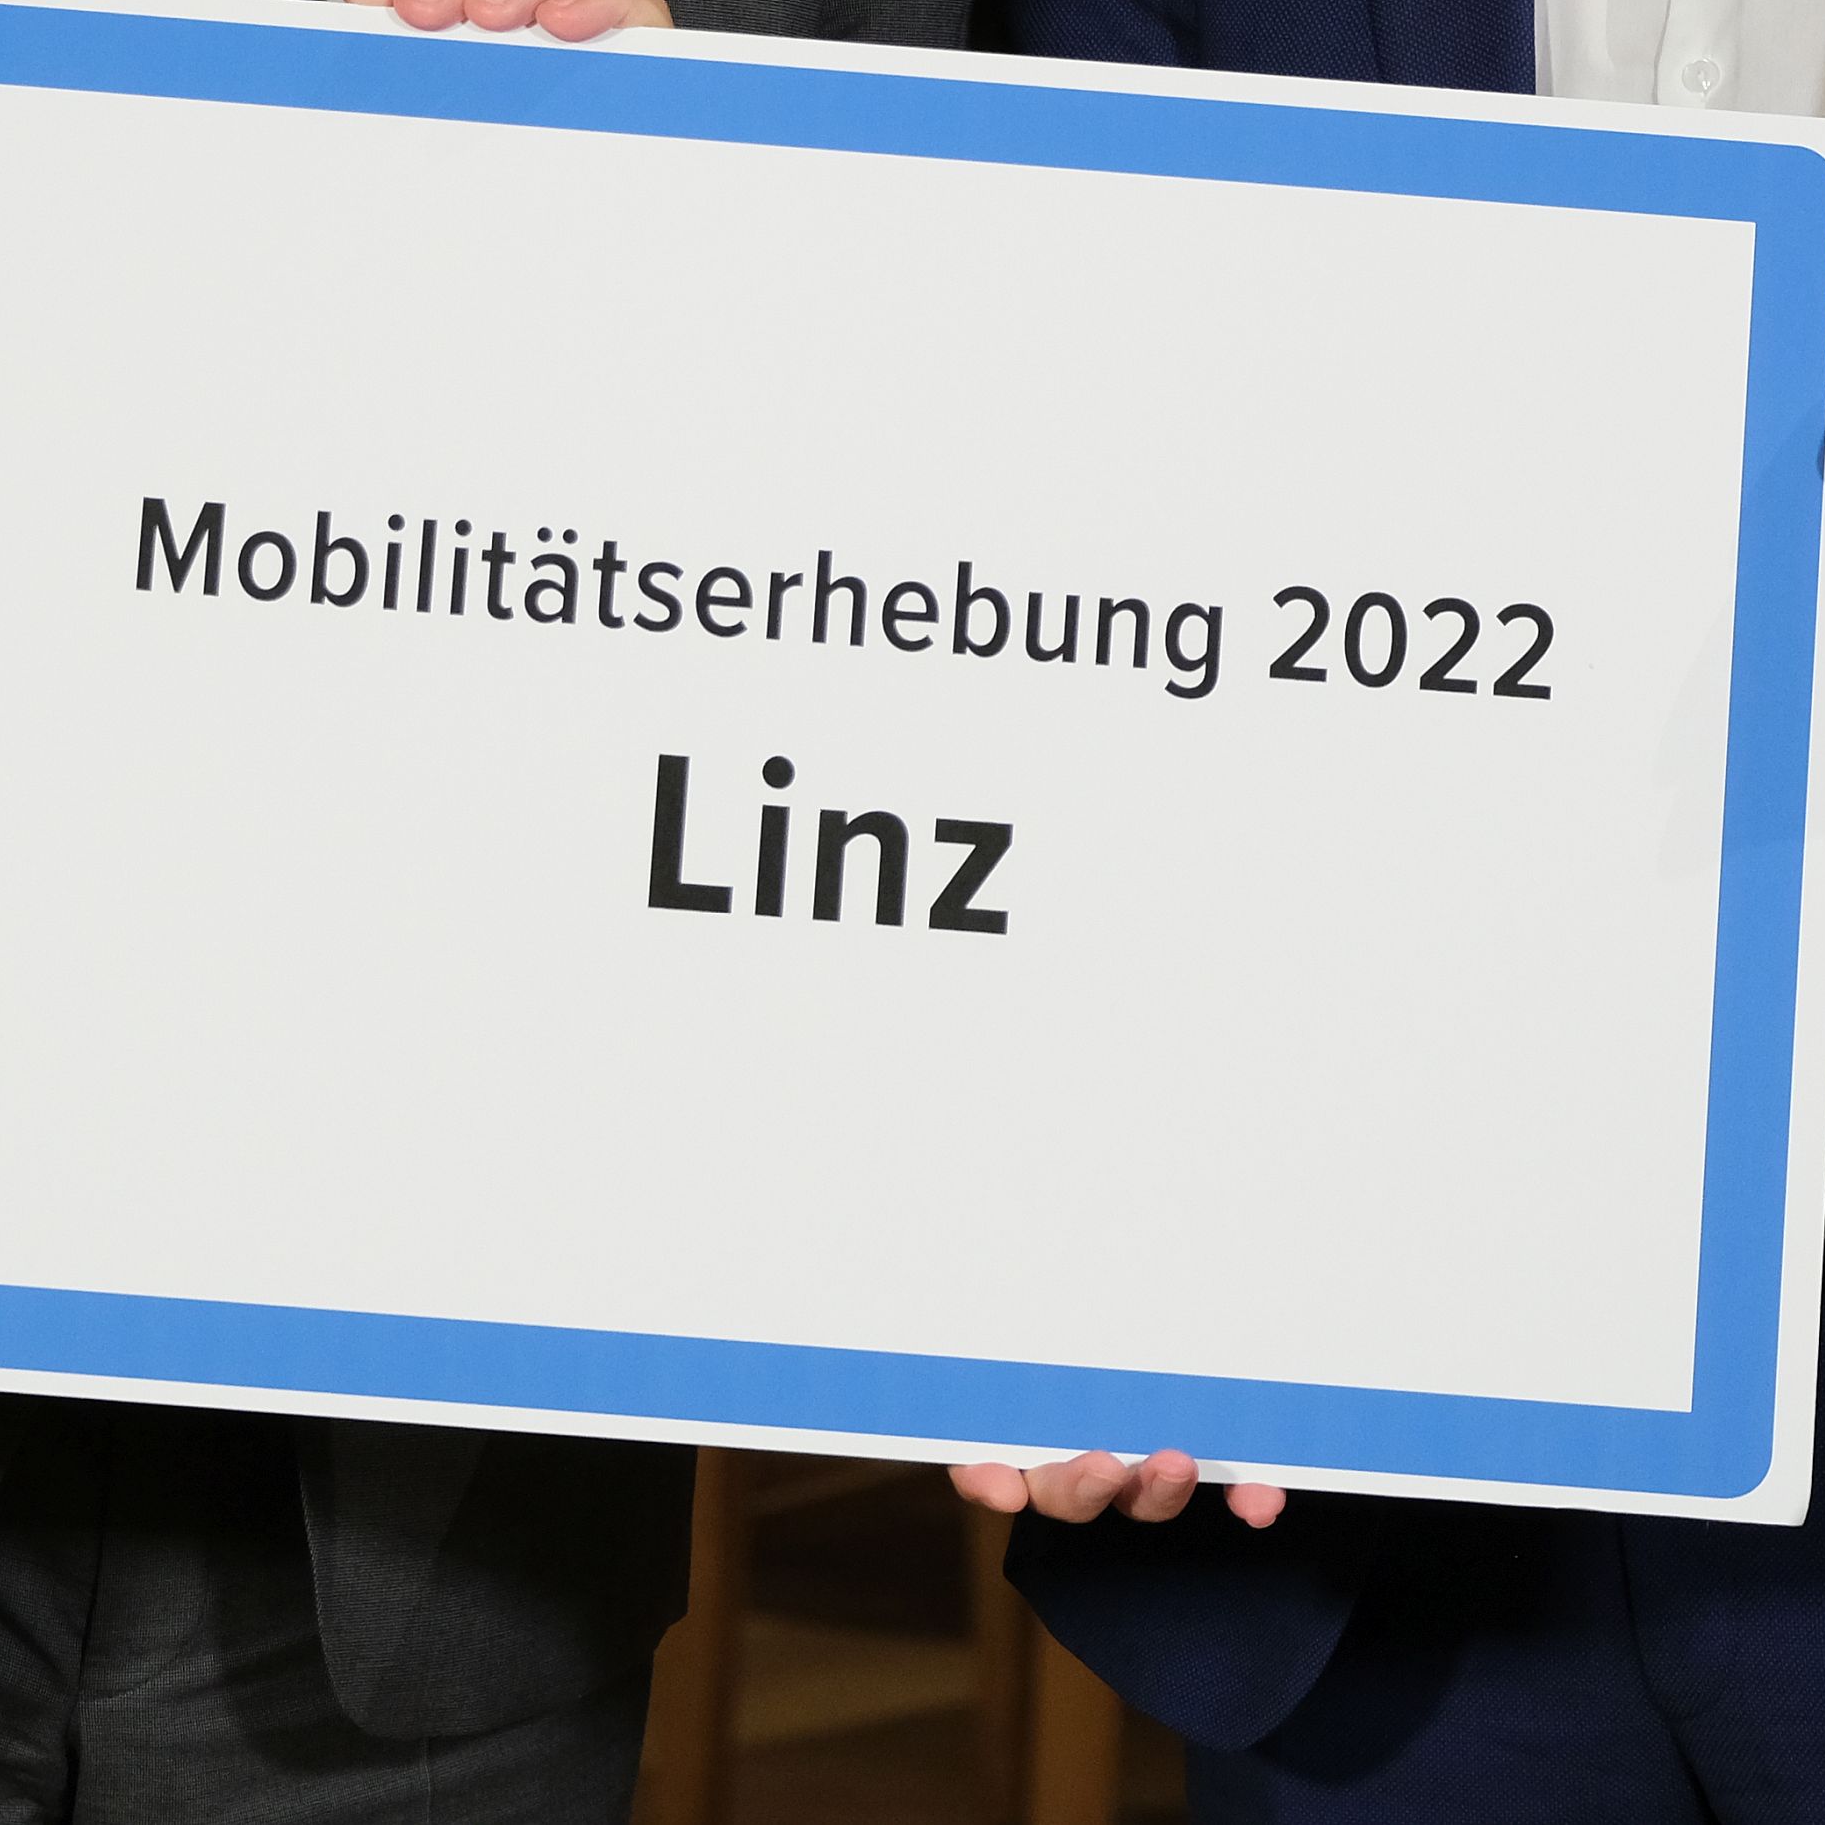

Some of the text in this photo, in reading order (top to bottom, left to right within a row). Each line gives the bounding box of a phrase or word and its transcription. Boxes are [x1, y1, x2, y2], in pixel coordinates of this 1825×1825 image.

[134, 495, 1555, 701] Mobilitätserhebung 2022
[646, 752, 1014, 936] Linz
